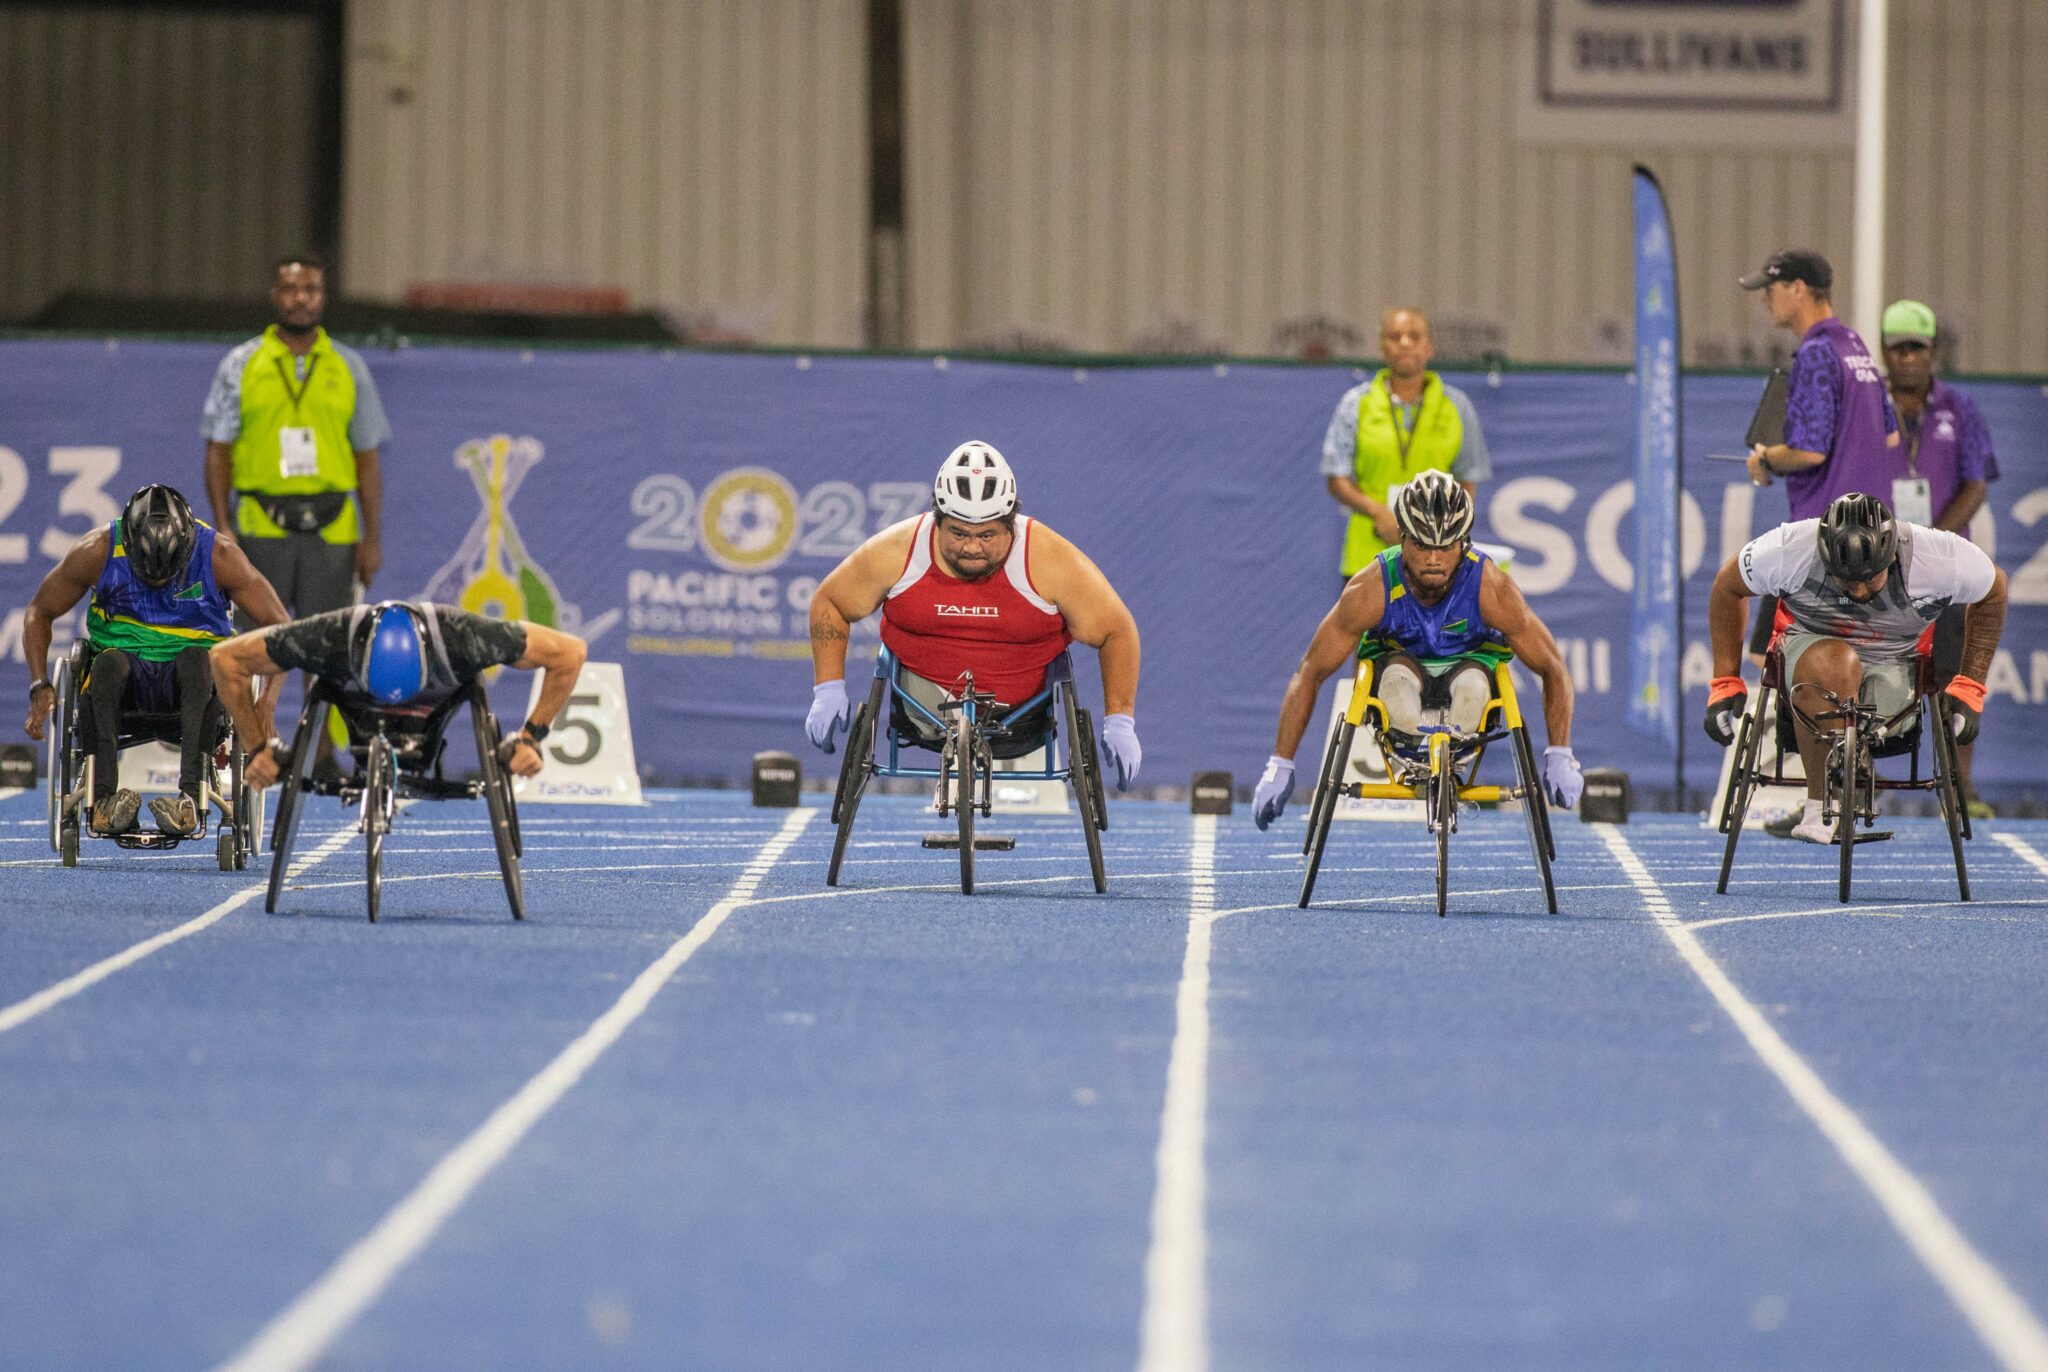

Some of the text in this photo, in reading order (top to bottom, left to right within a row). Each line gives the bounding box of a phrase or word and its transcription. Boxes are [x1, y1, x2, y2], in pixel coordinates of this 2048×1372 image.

[627, 569, 780, 611] PACIFIC
[934, 604, 999, 614] TAHITI
[549, 695, 601, 765] 5
